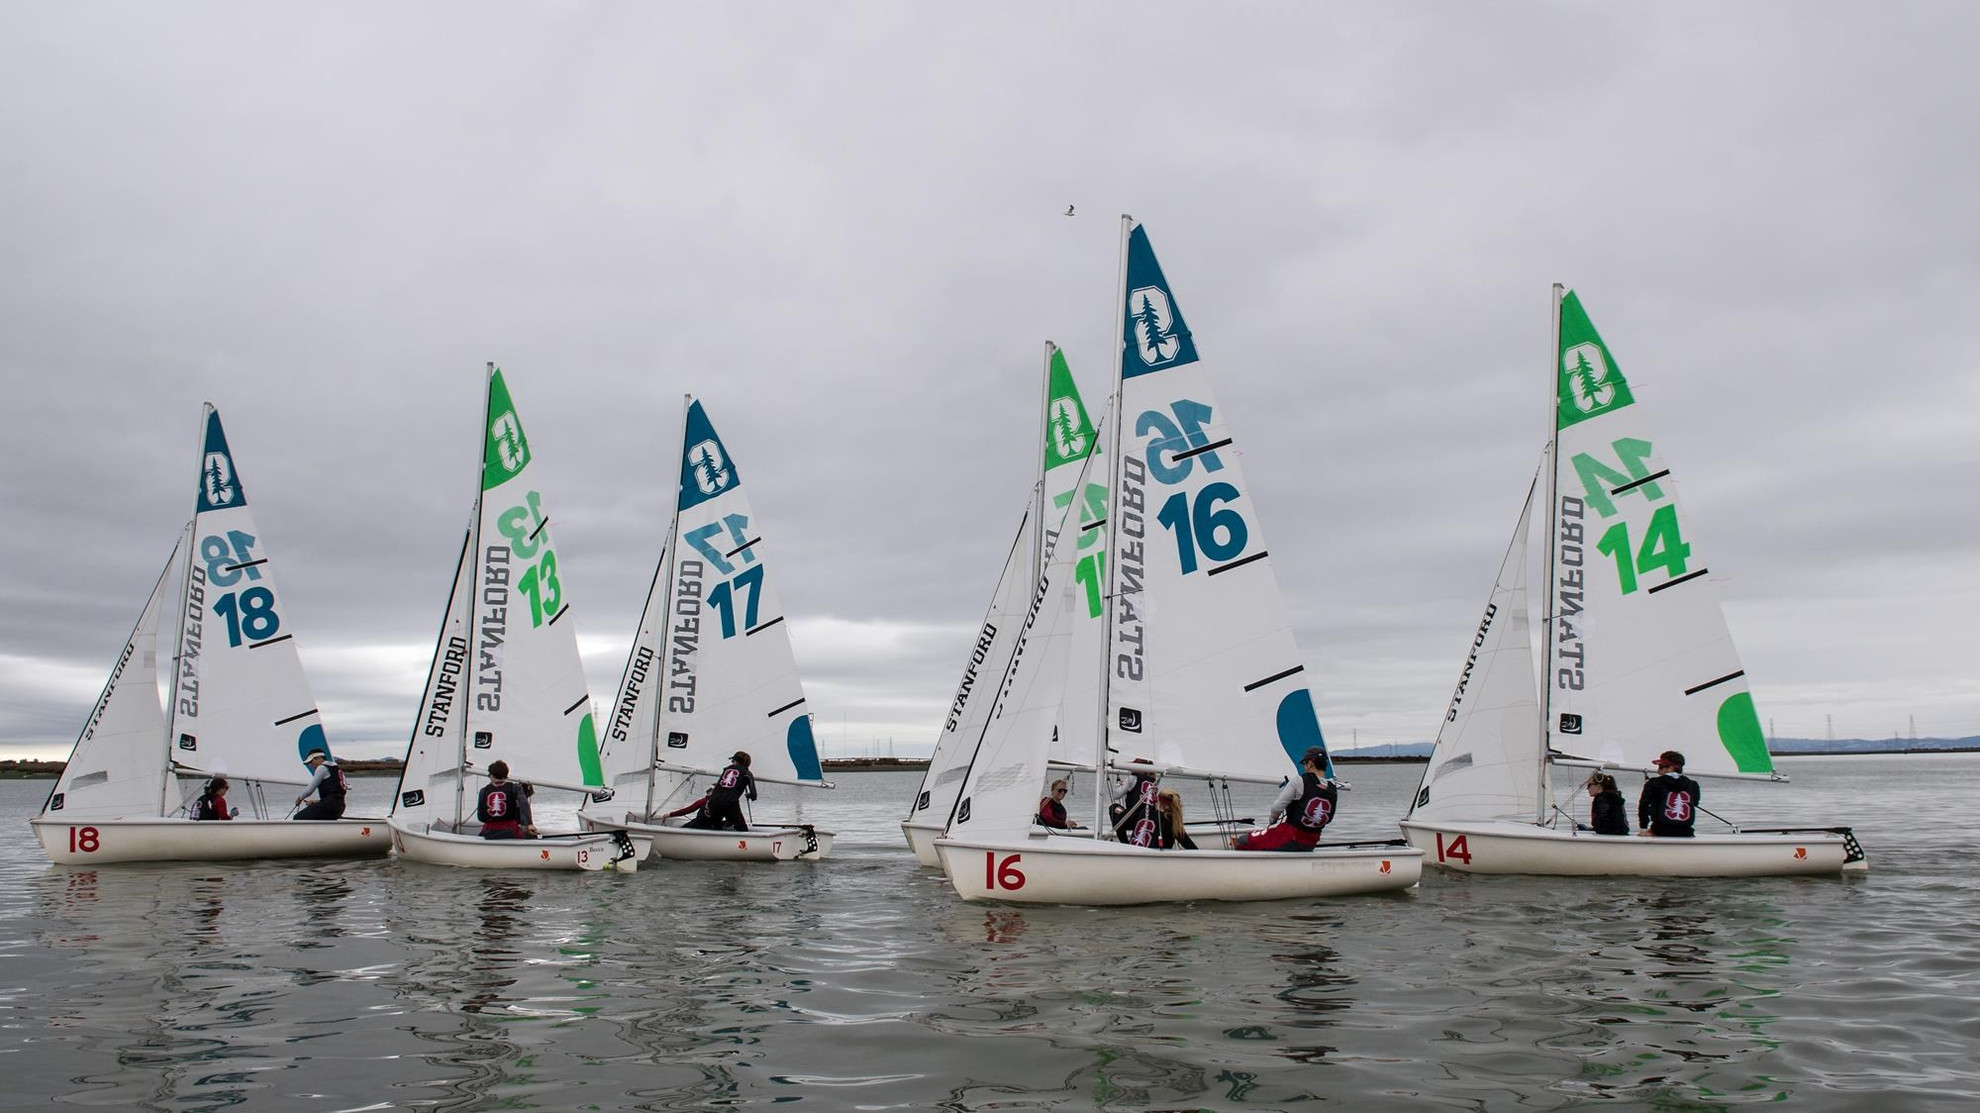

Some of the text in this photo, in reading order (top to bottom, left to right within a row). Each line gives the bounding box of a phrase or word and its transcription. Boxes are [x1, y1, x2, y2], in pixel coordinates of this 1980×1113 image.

[1157, 481, 1248, 575] 16
[1597, 503, 1691, 596] 14
[212, 587, 280, 648] 18
[518, 549, 562, 629] 13
[706, 563, 765, 640] 17
[1075, 549, 1109, 620] 1
[85, 643, 134, 741] STANFORD
[425, 637, 467, 738] STANFORD
[612, 646, 654, 742] STANFORD
[946, 622, 998, 733] STANFORD
[1447, 603, 1498, 723] STANFORD
[69, 826, 100, 853] 18
[1301, 796, 1332, 828] S
[1664, 791, 1691, 821] S
[577, 850, 589, 864] 13
[772, 841, 782, 854] 17
[985, 851, 1026, 890] 16
[1436, 832, 1472, 865] 14
